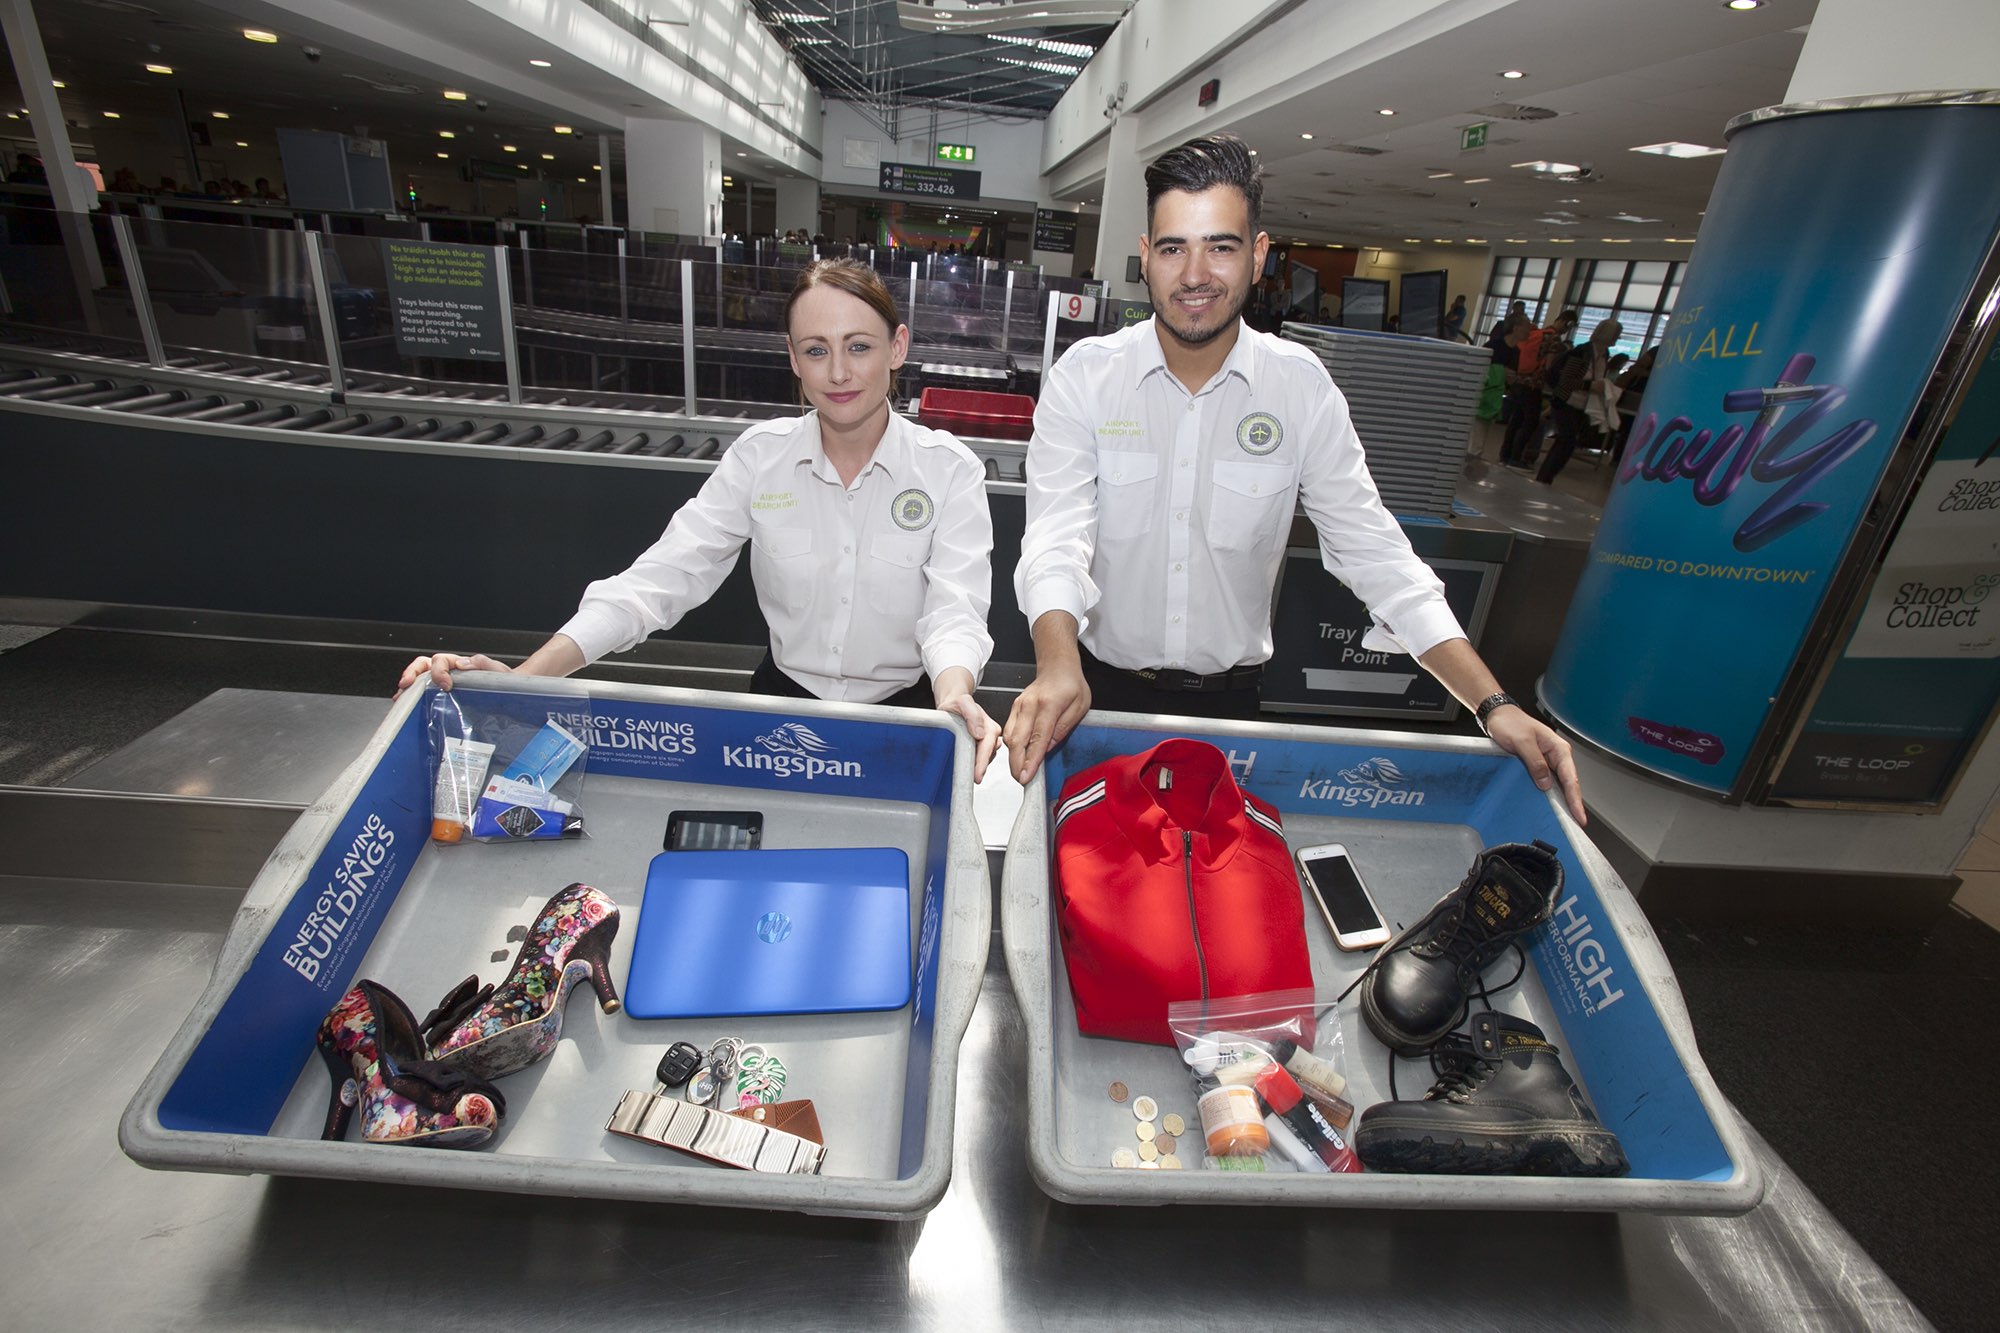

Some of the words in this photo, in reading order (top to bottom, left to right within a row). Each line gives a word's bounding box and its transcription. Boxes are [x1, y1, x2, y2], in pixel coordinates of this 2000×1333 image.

[917, 182, 955, 194] 332-426
[398, 298, 418, 308] Trays
[418, 299, 444, 308] behind
[445, 301, 459, 310] this
[400, 308, 426, 316] require
[427, 310, 463, 320] searching.
[1068, 296, 1082, 318] 9
[1124, 308, 1148, 320] Cuir
[400, 316, 424, 324] Please
[425, 318, 455, 327] proceed
[456, 320, 465, 328] to
[466, 321, 478, 329] the
[402, 326, 416, 334] end
[417, 326, 426, 334] of
[426, 326, 439, 334] the
[440, 328, 460, 338] X-ray
[417, 336, 440, 344] search
[1692, 322, 1763, 360] ALL
[1938, 494, 2000, 513] Collec
[1596, 552, 1653, 570] COMPARED
[1656, 558, 1678, 573] TO
[1894, 582, 1964, 610] Shop
[1886, 605, 1980, 629] Collect
[1319, 622, 1357, 644] Tray
[1342, 648, 1390, 665] Point
[626, 718, 694, 736] SAVING
[567, 726, 697, 755] UILDINGS
[1639, 726, 1664, 740] THE
[1668, 736, 1704, 754] LOOP
[589, 750, 614, 758] ingspan
[610, 756, 650, 764] consumption
[723, 746, 862, 780] Kingspan
[1816, 756, 1852, 768] THE
[1858, 759, 1910, 770] LOOP
[1298, 778, 1425, 808] Kingspan
[282, 882, 338, 968] ENERGY
[335, 814, 381, 884] SAVING
[296, 824, 395, 982] BUILDINGS
[316, 967, 330, 988] Every
[327, 951, 340, 968] year
[336, 919, 358, 952] Kingspan
[354, 892, 373, 921] solutions
[370, 877, 381, 892] save
[378, 868, 386, 878] six
[384, 851, 396, 869] times
[322, 978, 332, 992] the
[329, 953, 346, 979] annual
[342, 930, 359, 954] energy
[355, 889, 381, 930] consumption
[378, 881, 386, 890] of
[383, 862, 397, 882] Dublin
[1554, 894, 1624, 1010] HIGH
[1546, 915, 1596, 1018] PERFORMANCE
[1307, 1103, 1345, 1150] Gillette
